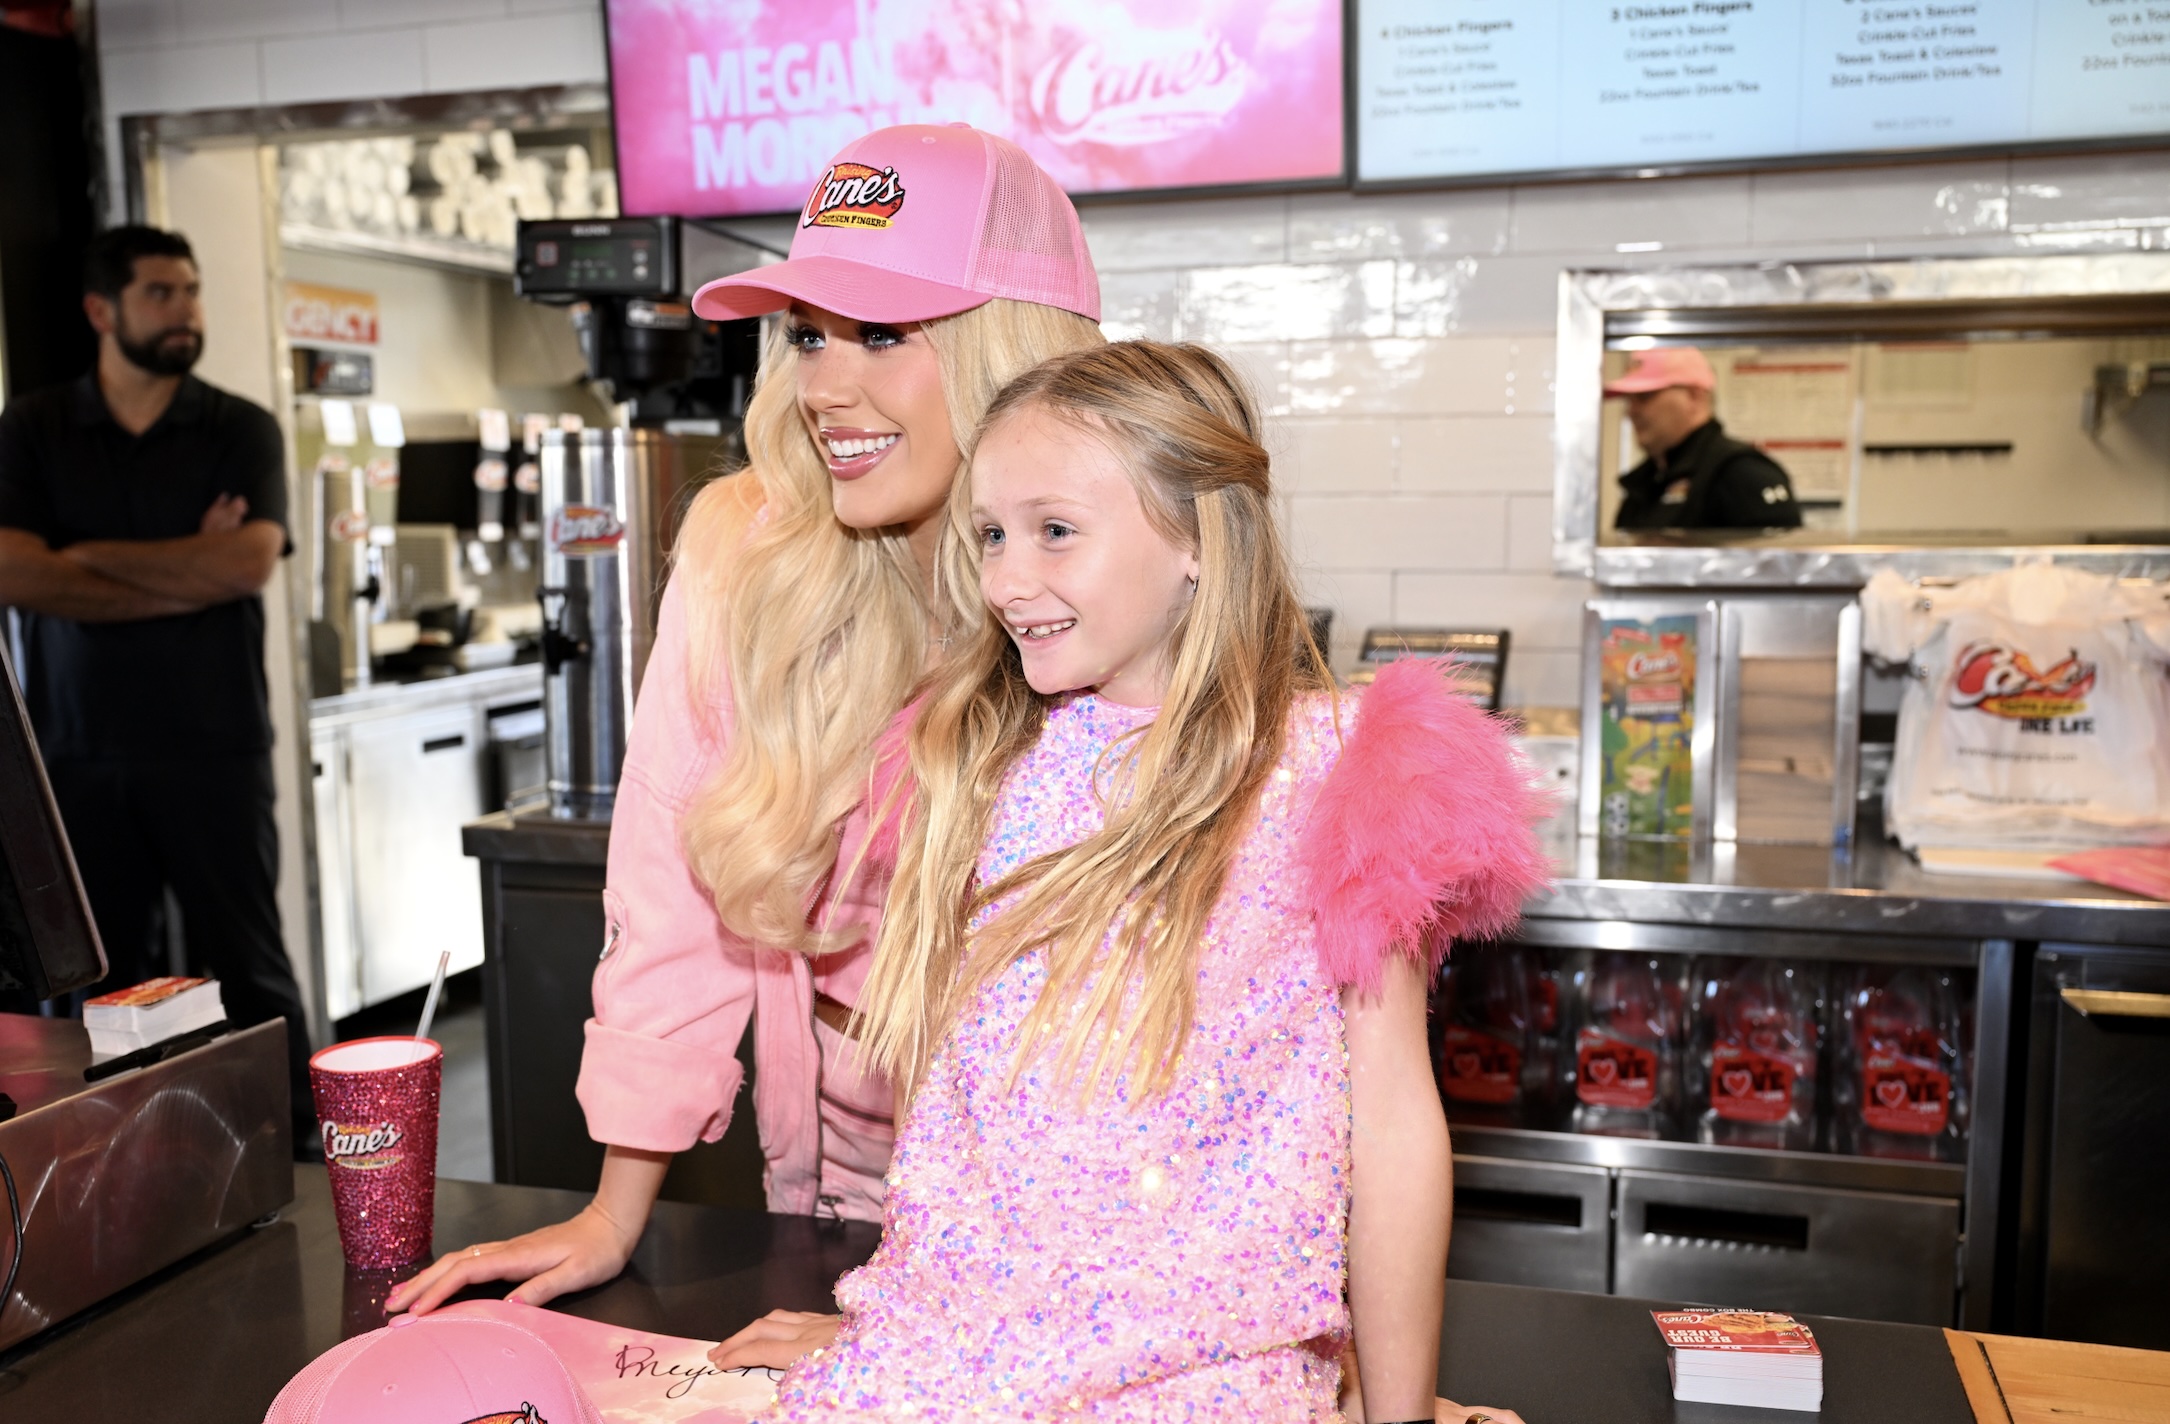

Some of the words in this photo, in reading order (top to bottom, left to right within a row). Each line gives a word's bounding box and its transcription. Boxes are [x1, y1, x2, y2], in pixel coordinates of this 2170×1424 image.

[1624, 5, 1688, 20] Chicken
[1693, 1, 1753, 16] Fingers
[688, 38, 895, 120] MEGAN
[835, 166, 872, 179] Raising
[804, 166, 904, 228] Cane's
[851, 216, 887, 227] FINGERS
[322, 1121, 403, 1160] Cane's
[1661, 1313, 1701, 1324] Cane's
[1668, 1329, 1721, 1337] GUEST
